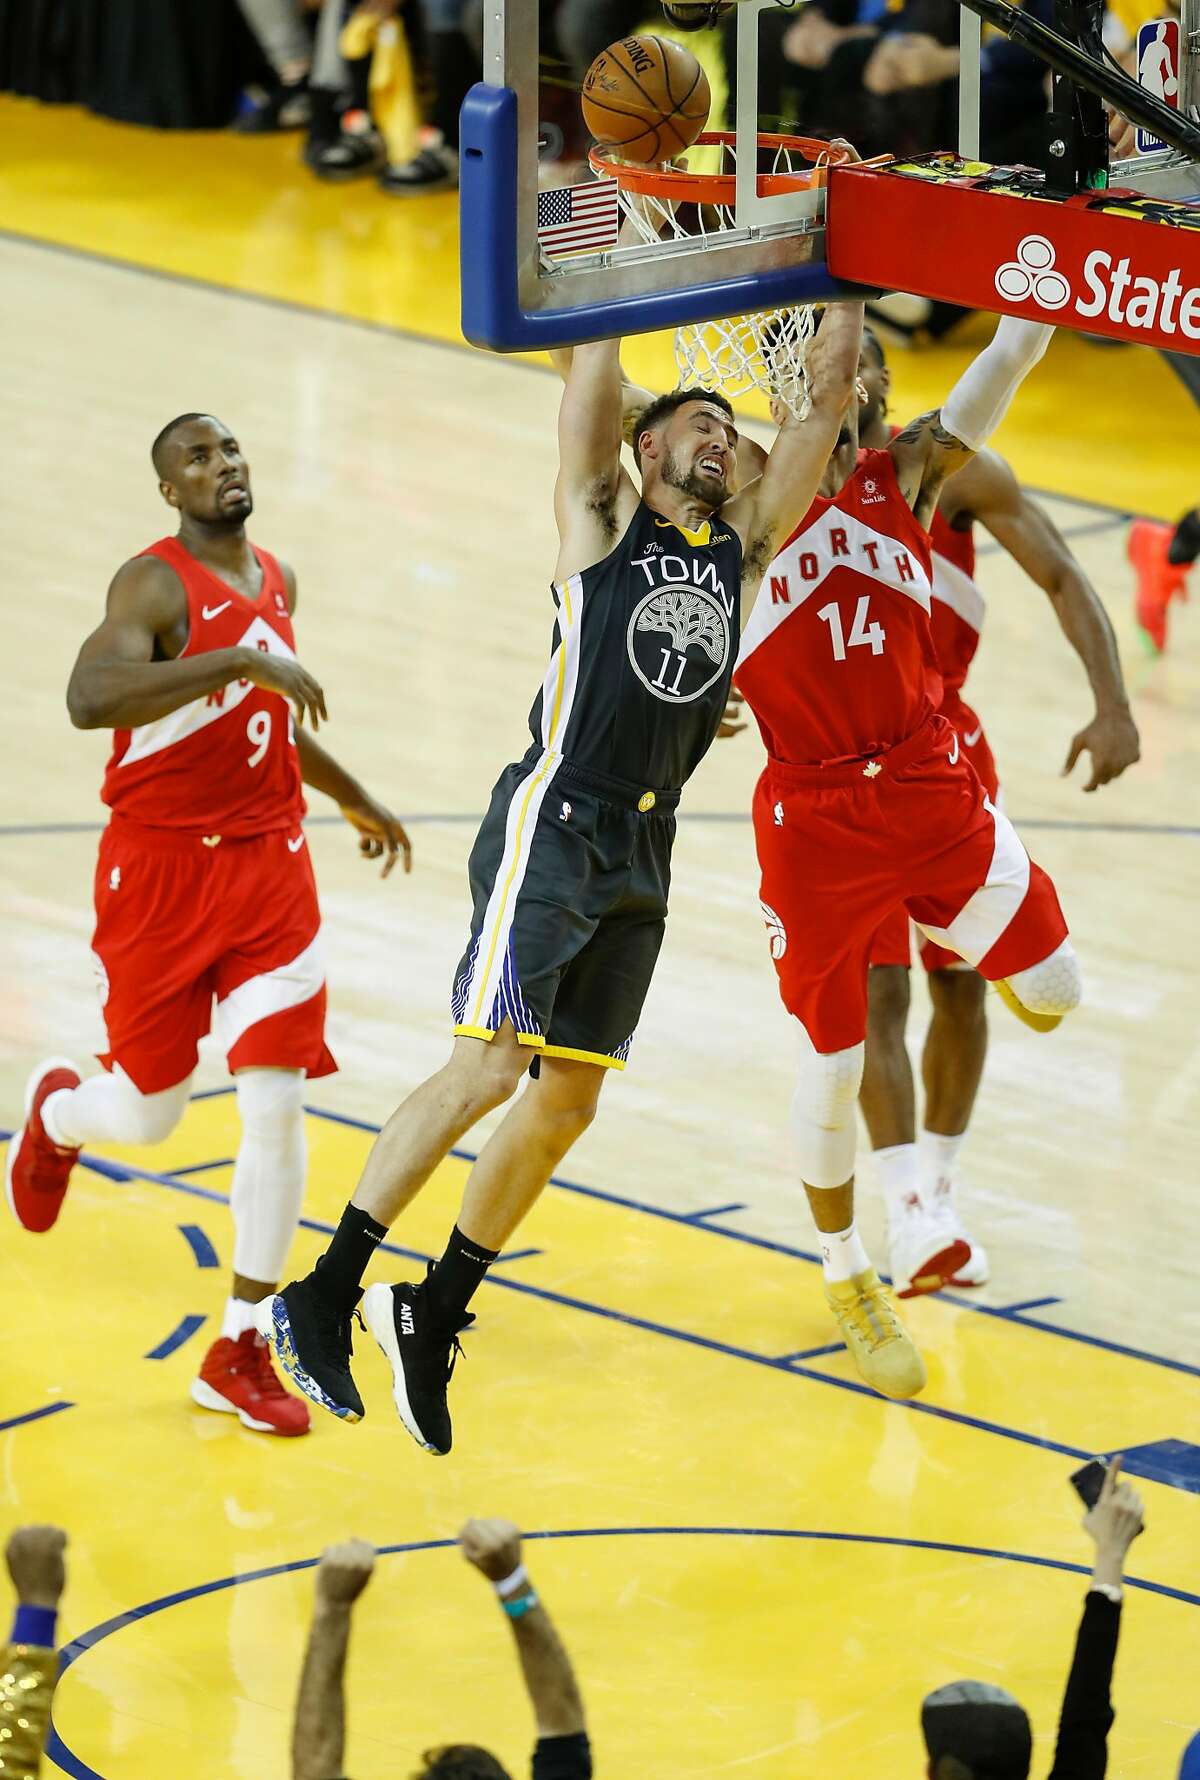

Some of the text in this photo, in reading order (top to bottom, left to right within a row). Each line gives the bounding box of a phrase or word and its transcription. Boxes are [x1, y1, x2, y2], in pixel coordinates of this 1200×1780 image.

[623, 37, 656, 74] DING
[1075, 250, 1200, 339] State
[643, 541, 664, 554] The
[769, 527, 916, 605] NORTH
[631, 555, 735, 618] TOWN
[816, 595, 886, 661] 14
[651, 647, 687, 696] 11
[246, 710, 271, 768] 9
[400, 1302, 415, 1335] ANTA
